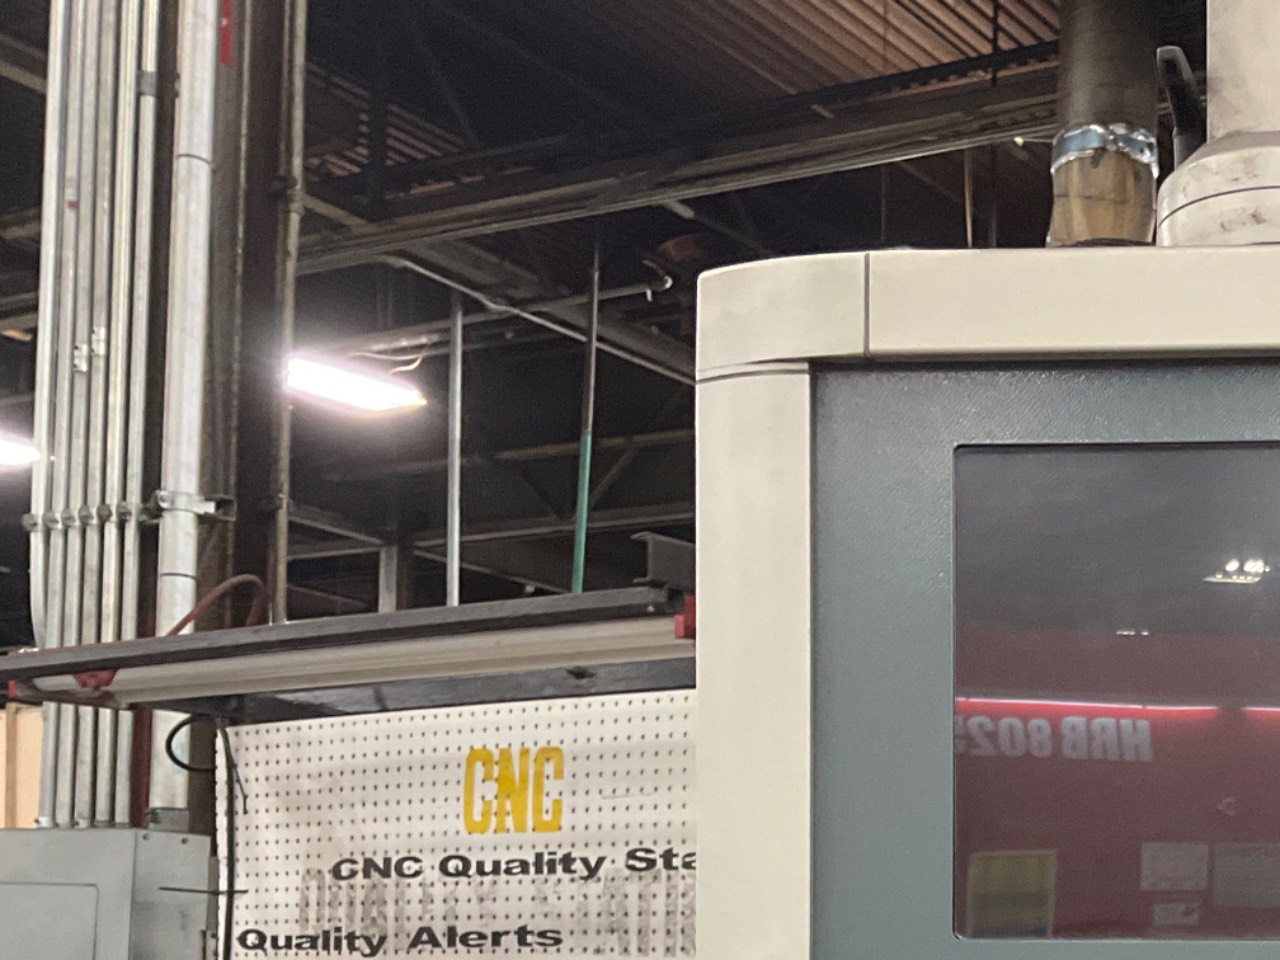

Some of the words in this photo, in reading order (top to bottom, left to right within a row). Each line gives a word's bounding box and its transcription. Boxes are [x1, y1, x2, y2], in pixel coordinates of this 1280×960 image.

[463, 746, 565, 835] CNC
[332, 856, 423, 881] CNC
[439, 852, 608, 881] Quality
[237, 927, 388, 958] Quality
[407, 924, 564, 948] Alerts
